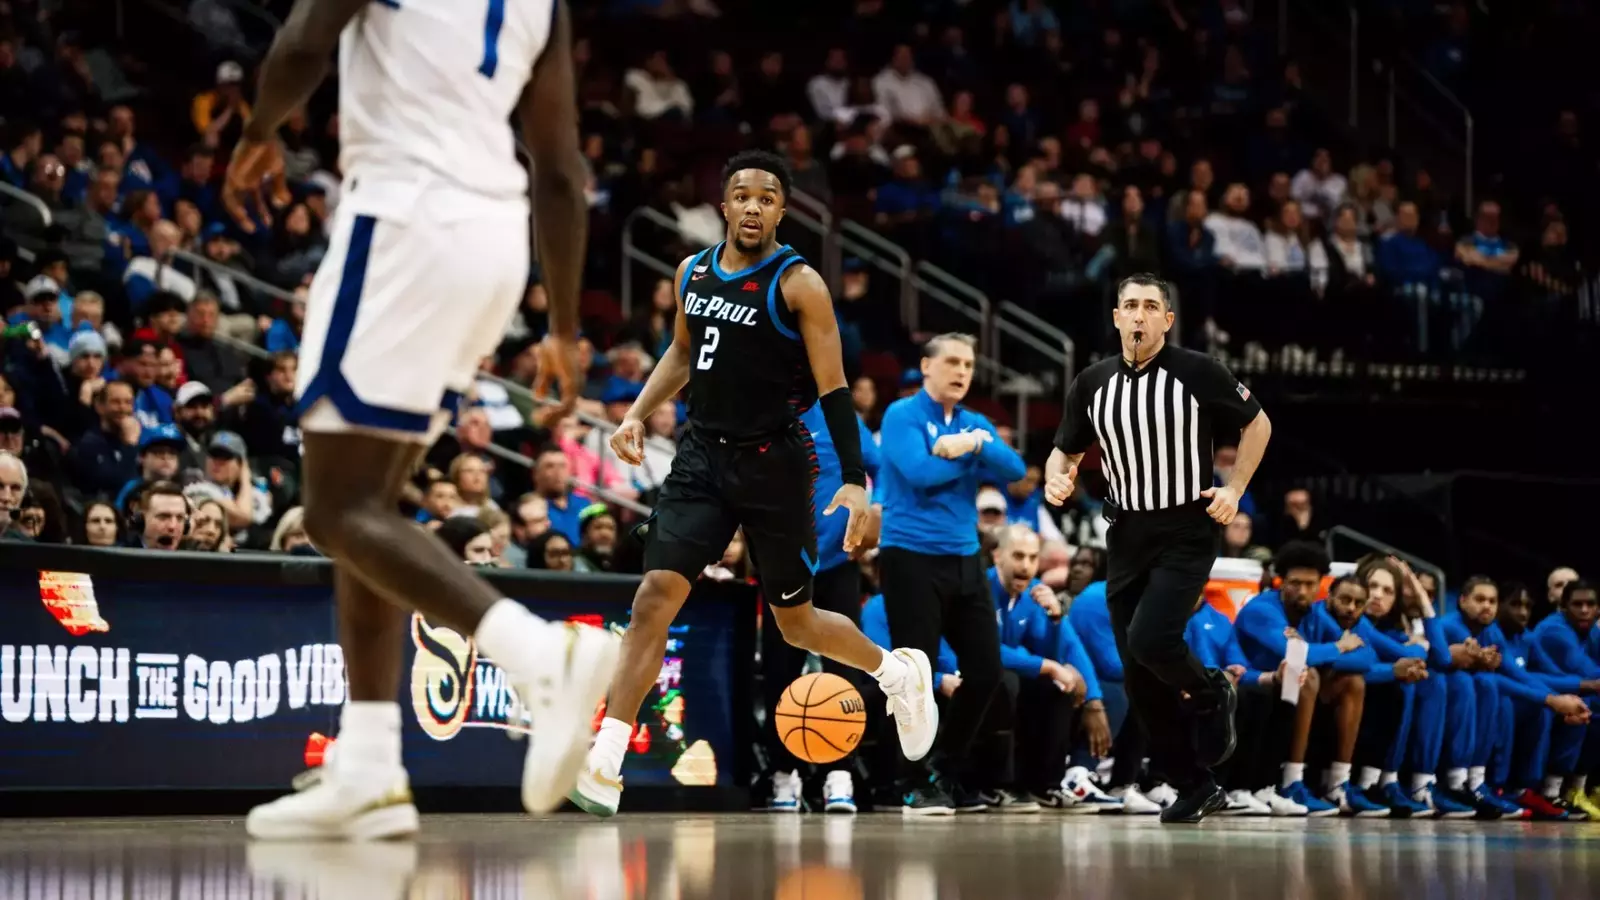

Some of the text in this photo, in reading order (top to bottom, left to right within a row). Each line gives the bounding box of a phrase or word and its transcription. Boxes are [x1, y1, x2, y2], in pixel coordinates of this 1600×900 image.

[697, 326, 720, 370] 2
[0, 643, 350, 724] UNCH THE GOOD VIB
[475, 664, 532, 721] WIS
